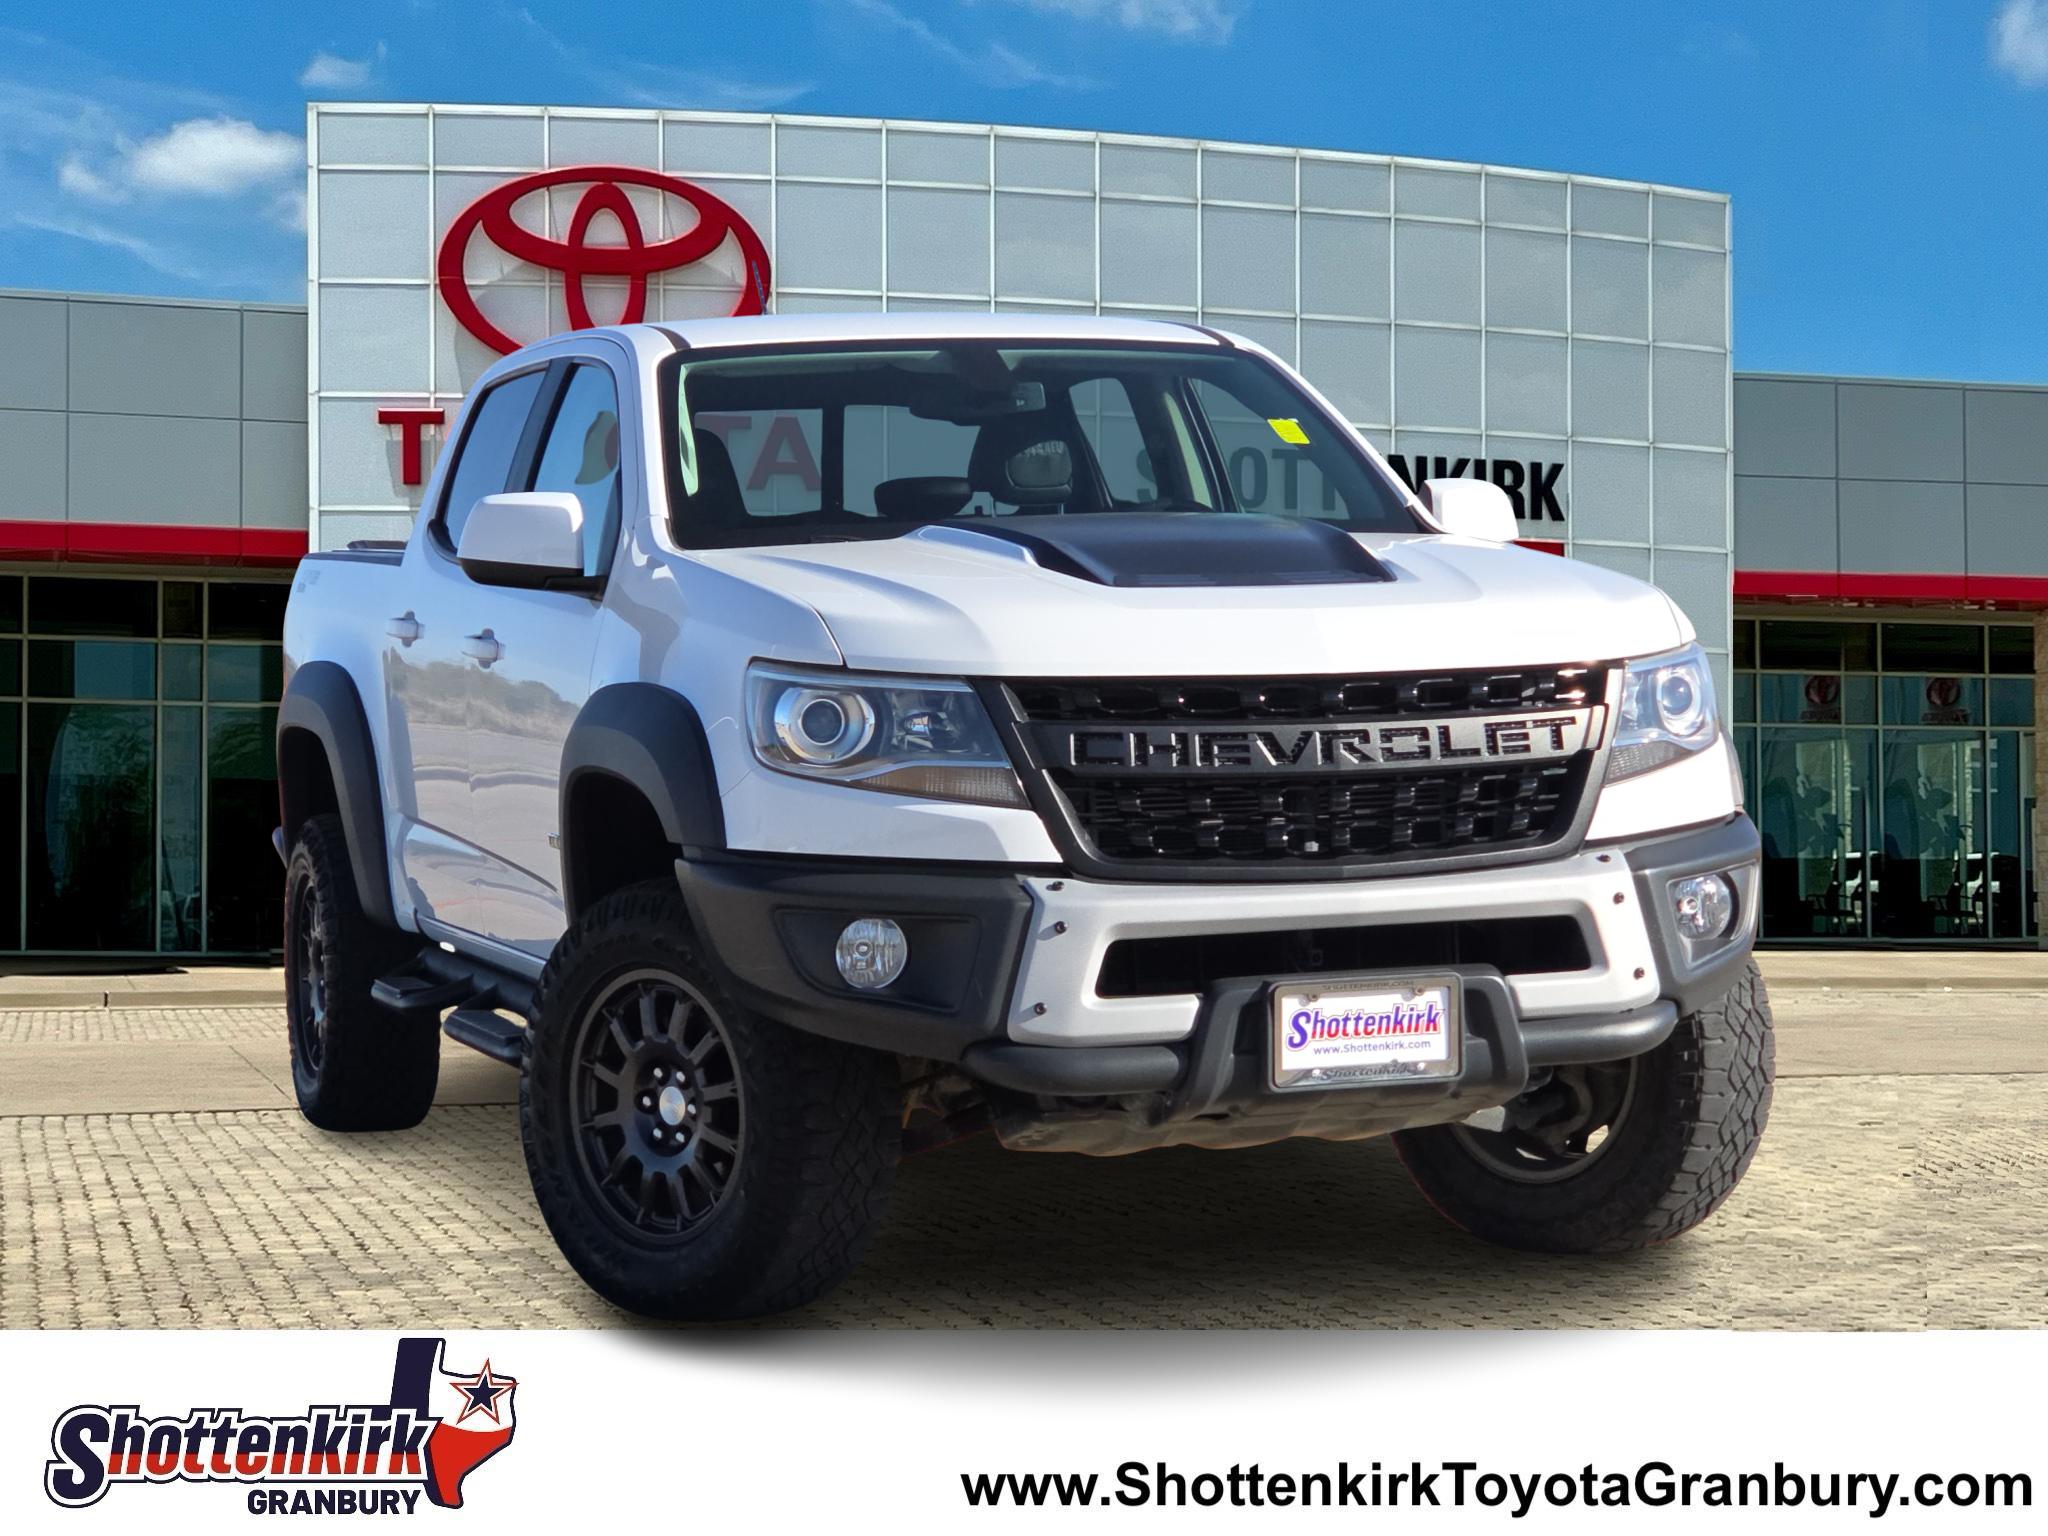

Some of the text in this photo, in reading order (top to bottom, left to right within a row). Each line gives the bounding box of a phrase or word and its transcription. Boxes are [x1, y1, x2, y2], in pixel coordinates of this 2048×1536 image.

[1069, 715, 1578, 766] CHEVROLET
[1287, 1003, 1441, 1050] Shottenkirk
[1313, 1039, 1431, 1055] www.Shottenkirk.com
